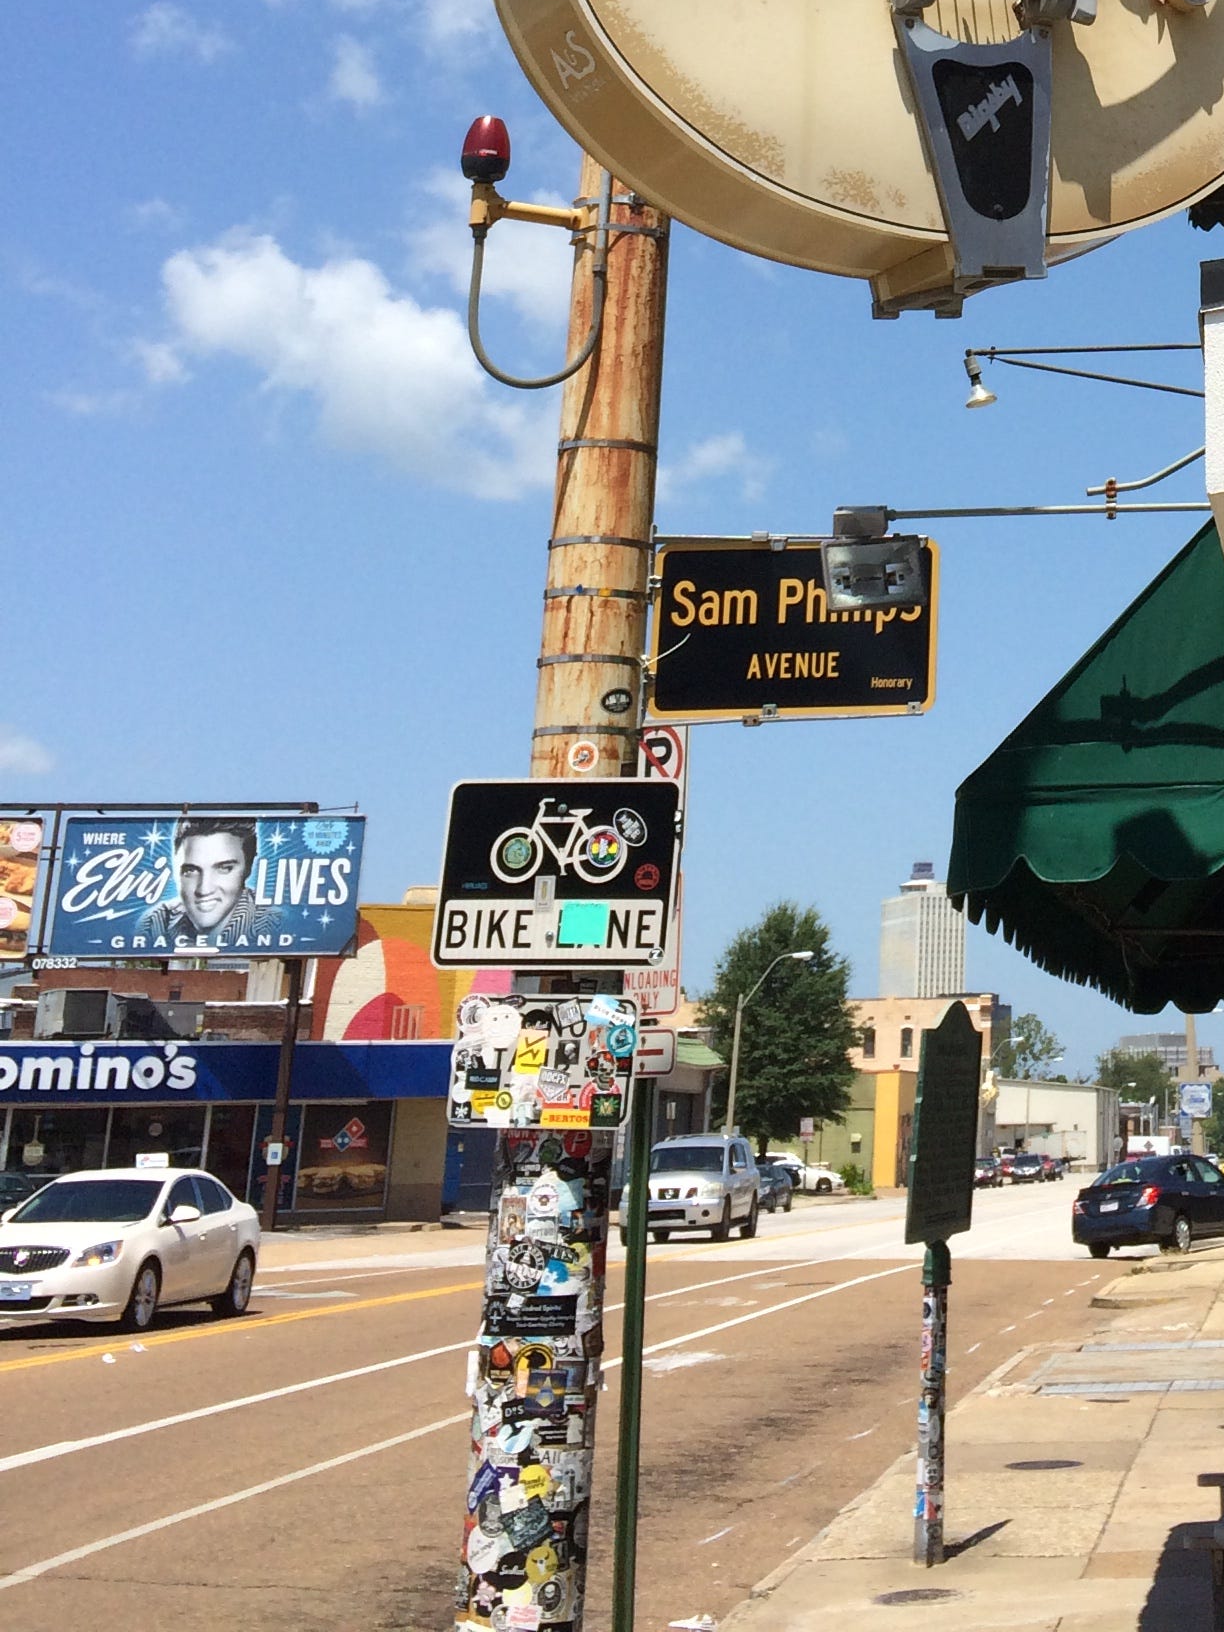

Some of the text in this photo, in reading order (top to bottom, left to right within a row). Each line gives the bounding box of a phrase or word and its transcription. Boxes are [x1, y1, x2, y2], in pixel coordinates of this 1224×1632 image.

[671, 580, 757, 627] Sam
[747, 651, 840, 680] AVENUE
[871, 676, 913, 690] Honorary
[82, 832, 126, 846] WHERE
[61, 848, 351, 913] Elvis LIVES
[111, 934, 294, 949] GRACELAND
[445, 910, 656, 949] BIKE LNE
[32, 957, 77, 970] 078332
[624, 970, 677, 989] NLOADING
[0, 1043, 198, 1091] omino's
